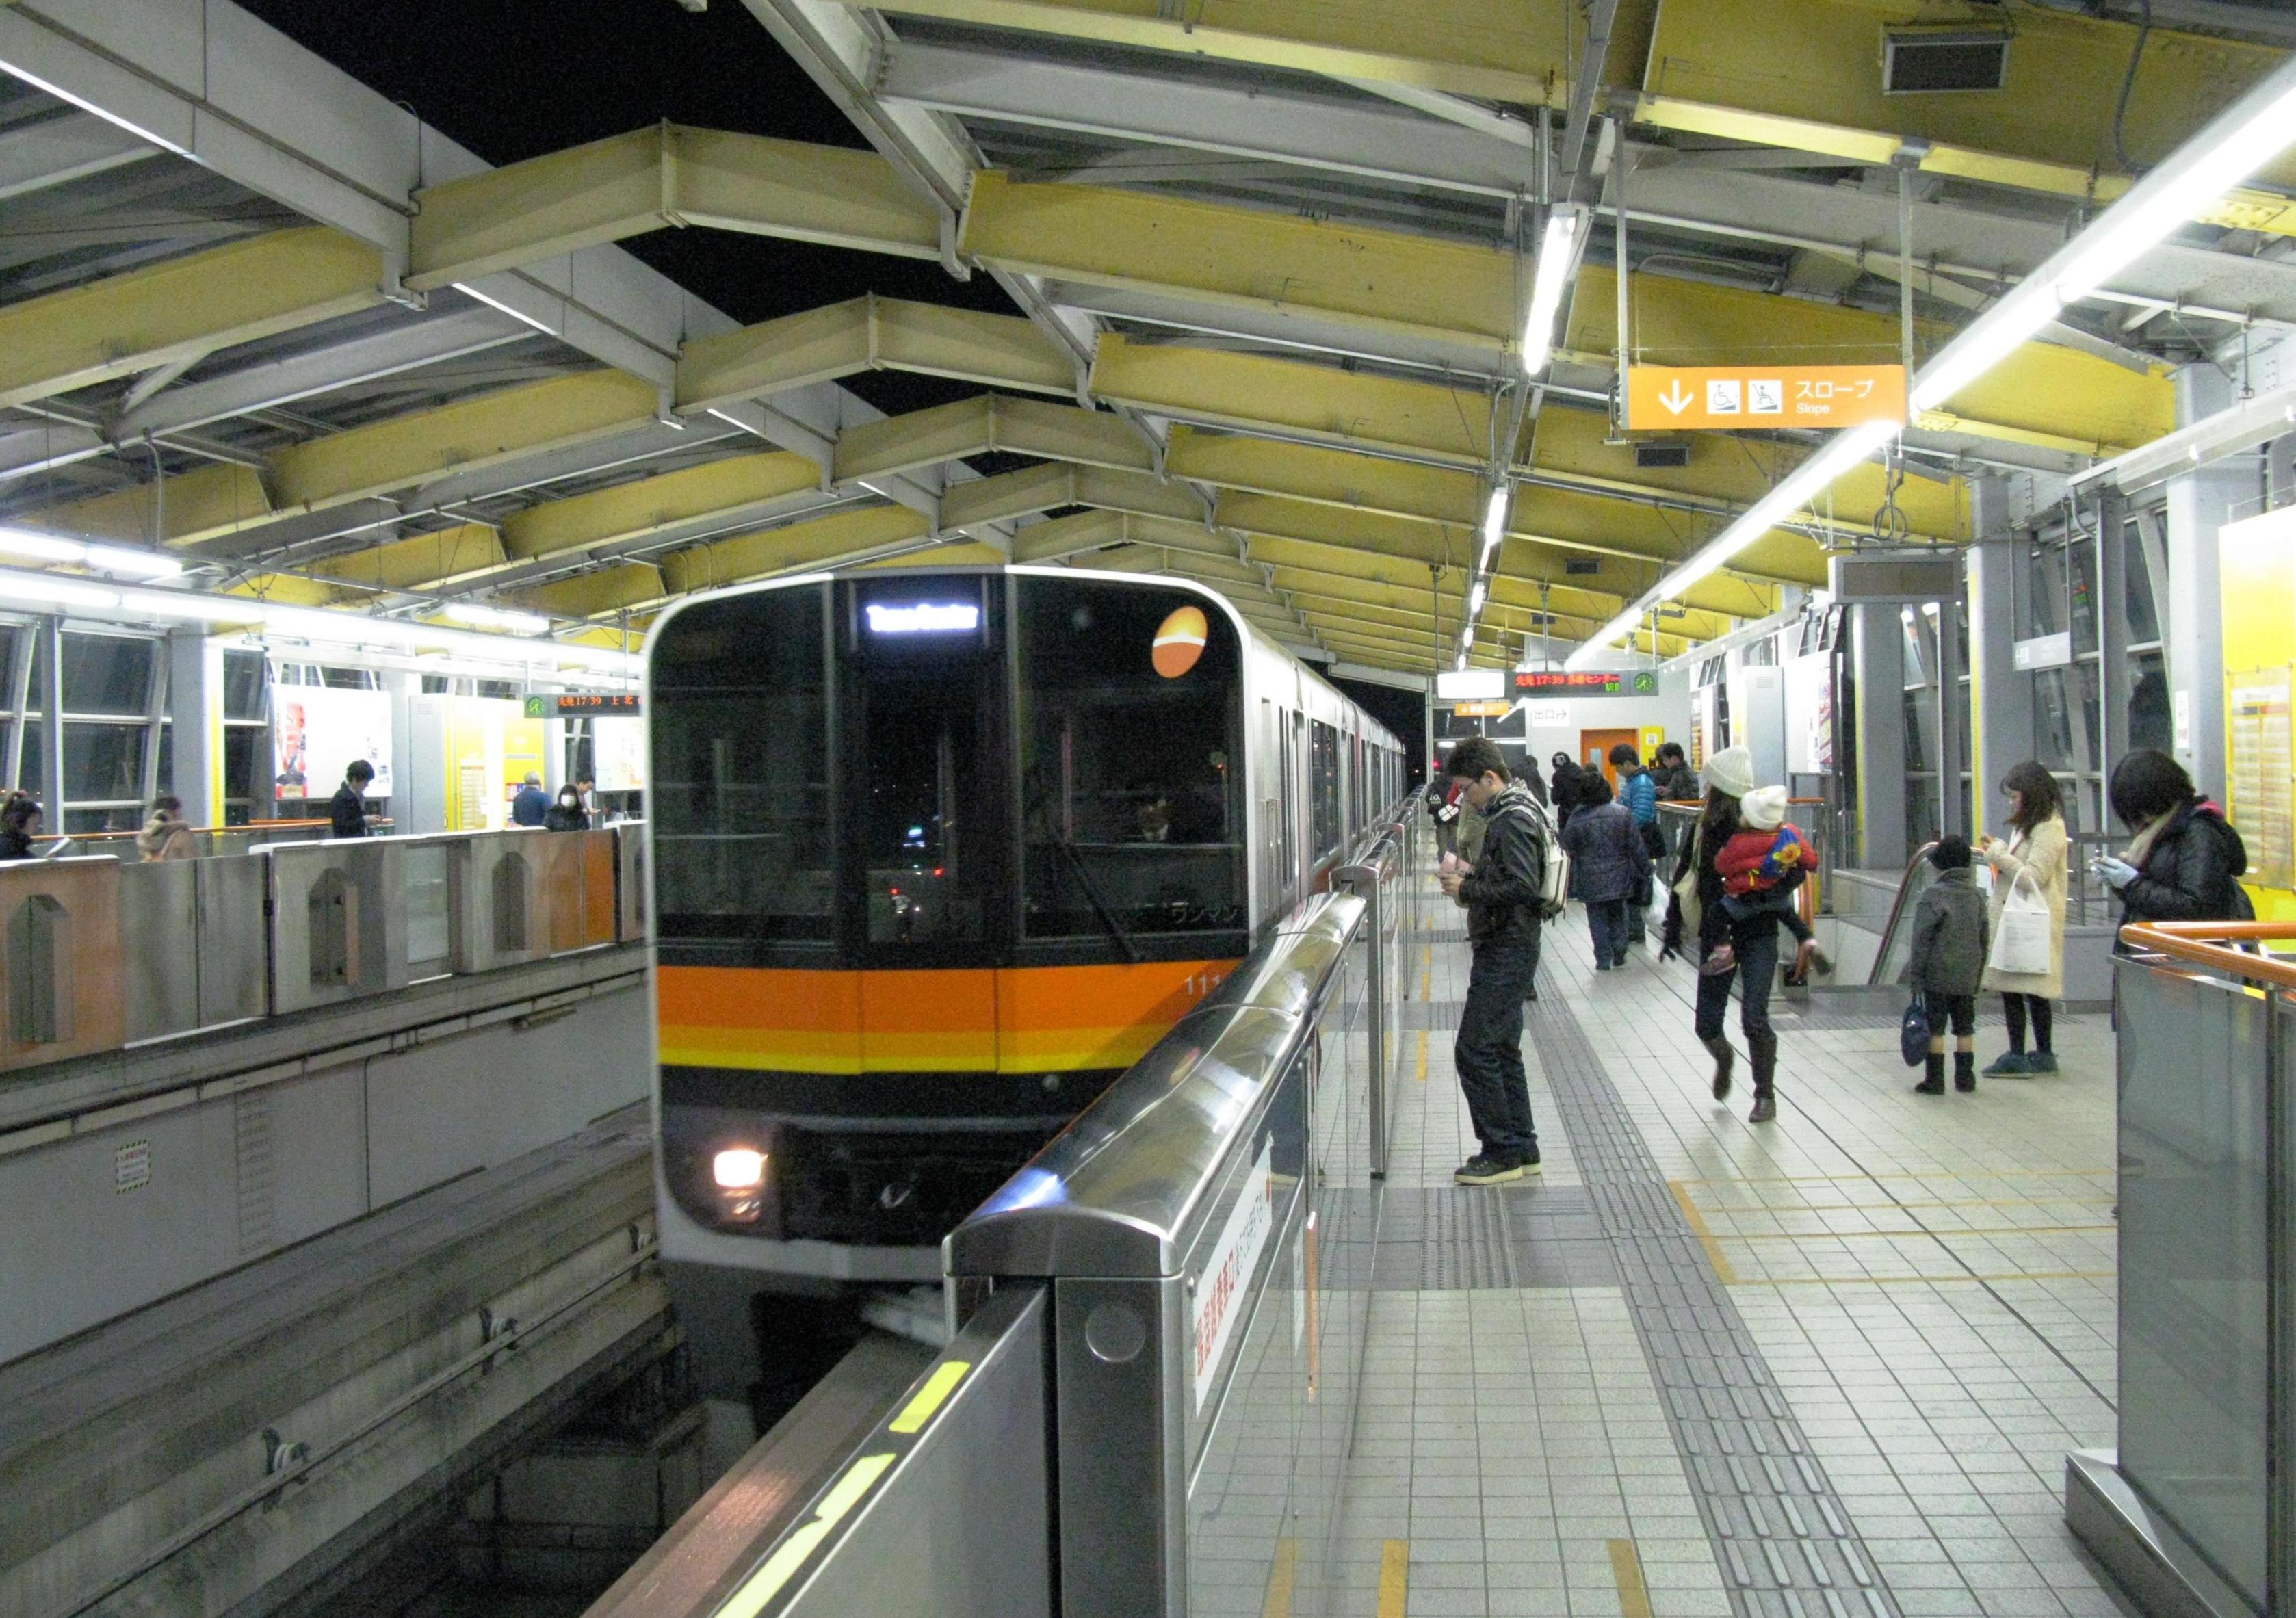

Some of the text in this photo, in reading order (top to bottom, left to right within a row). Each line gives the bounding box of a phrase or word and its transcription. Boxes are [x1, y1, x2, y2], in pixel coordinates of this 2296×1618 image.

[1796, 380, 1875, 398] スロープ
[1797, 403, 1830, 415] Slope
[1537, 675, 1566, 685] 17:39
[577, 697, 601, 706] 17:39
[1534, 709, 1555, 719] 出口
[1171, 902, 1238, 924] ワンマン
